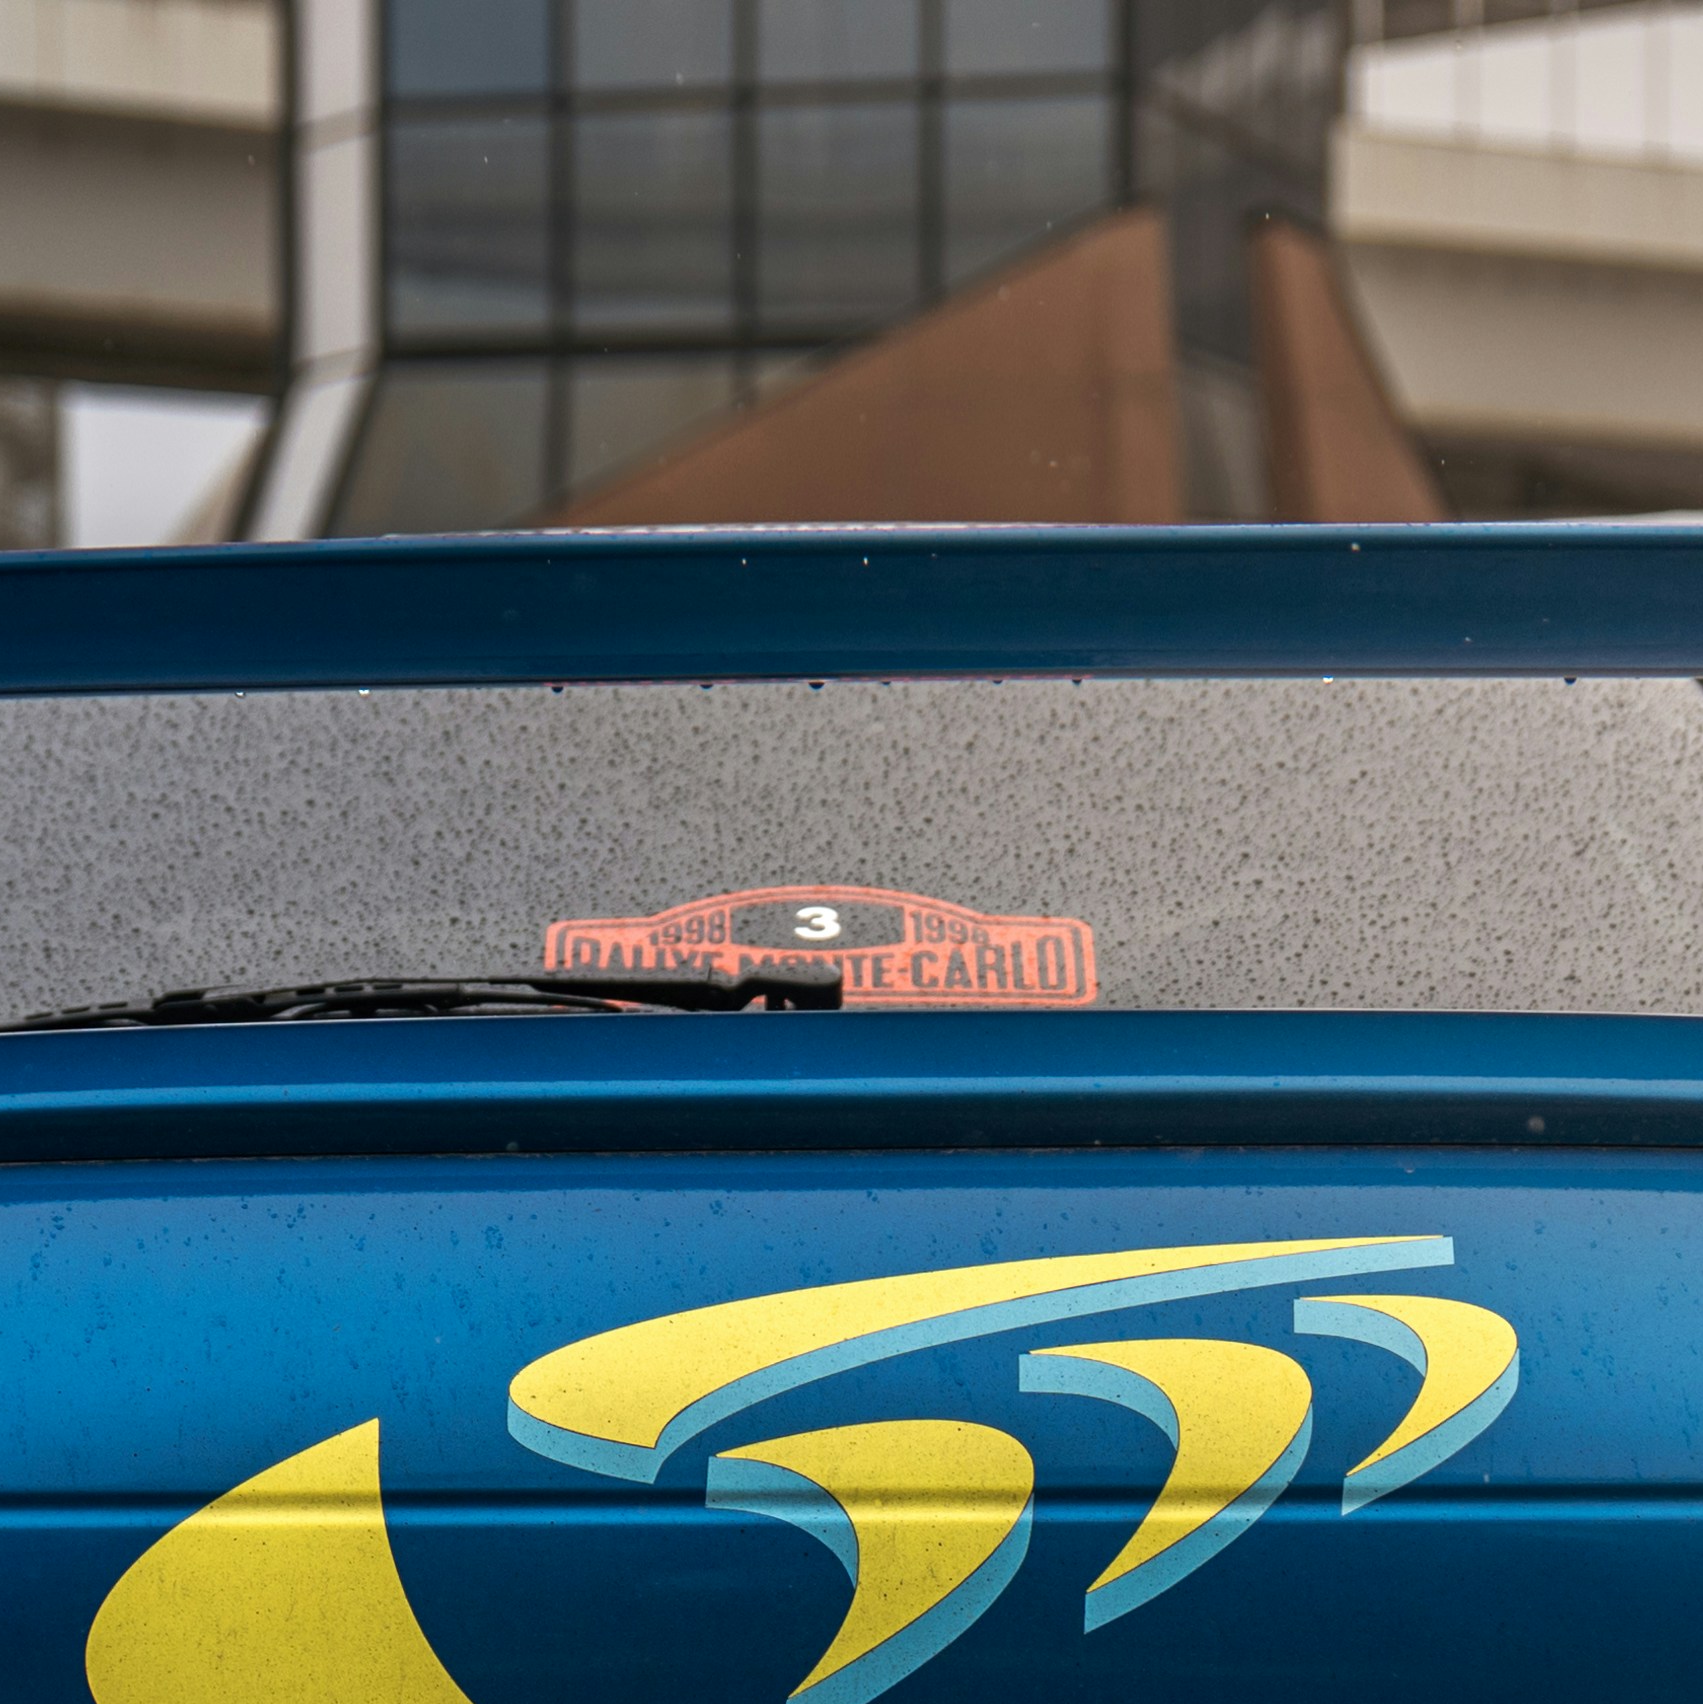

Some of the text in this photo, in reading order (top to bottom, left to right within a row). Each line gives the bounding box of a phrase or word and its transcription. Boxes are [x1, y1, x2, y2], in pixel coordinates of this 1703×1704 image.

[649, 906, 990, 946] 1998 3 1998
